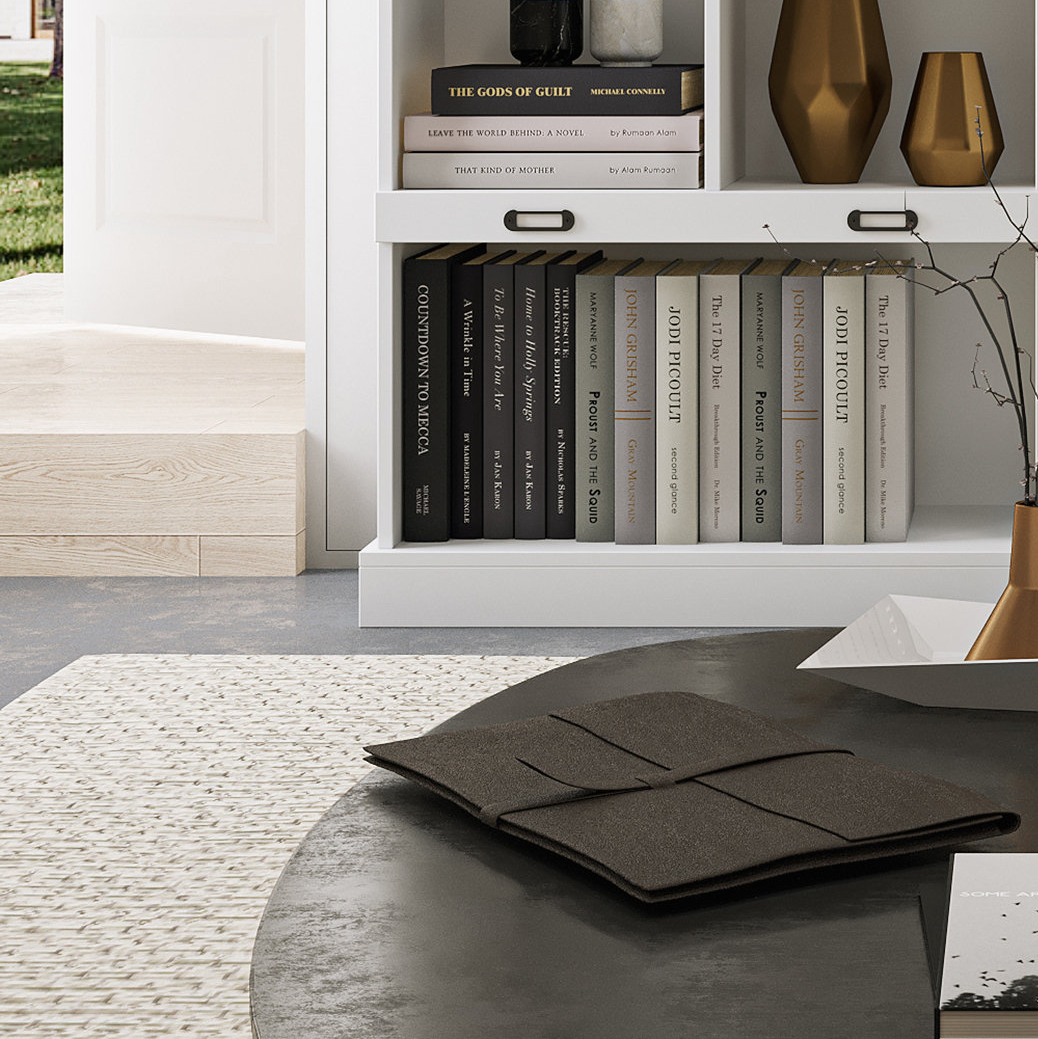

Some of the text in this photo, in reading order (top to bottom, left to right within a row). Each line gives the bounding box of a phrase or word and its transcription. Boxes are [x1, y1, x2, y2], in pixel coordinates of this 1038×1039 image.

[449, 87, 572, 97] THE GODS OF GUILT
[418, 285, 429, 455] COUNTDOWN TO MECCA
[464, 299, 473, 396] A Wrinkle in Time
[495, 289, 504, 410] To Be Where You Are
[523, 288, 536, 421] Home to Holly Springs
[624, 289, 639, 401] JOHN GRISHAM
[669, 306, 680, 423] JODI PICOULT
[710, 295, 722, 388] The 17 Day Diet
[670, 483, 678, 514] glance
